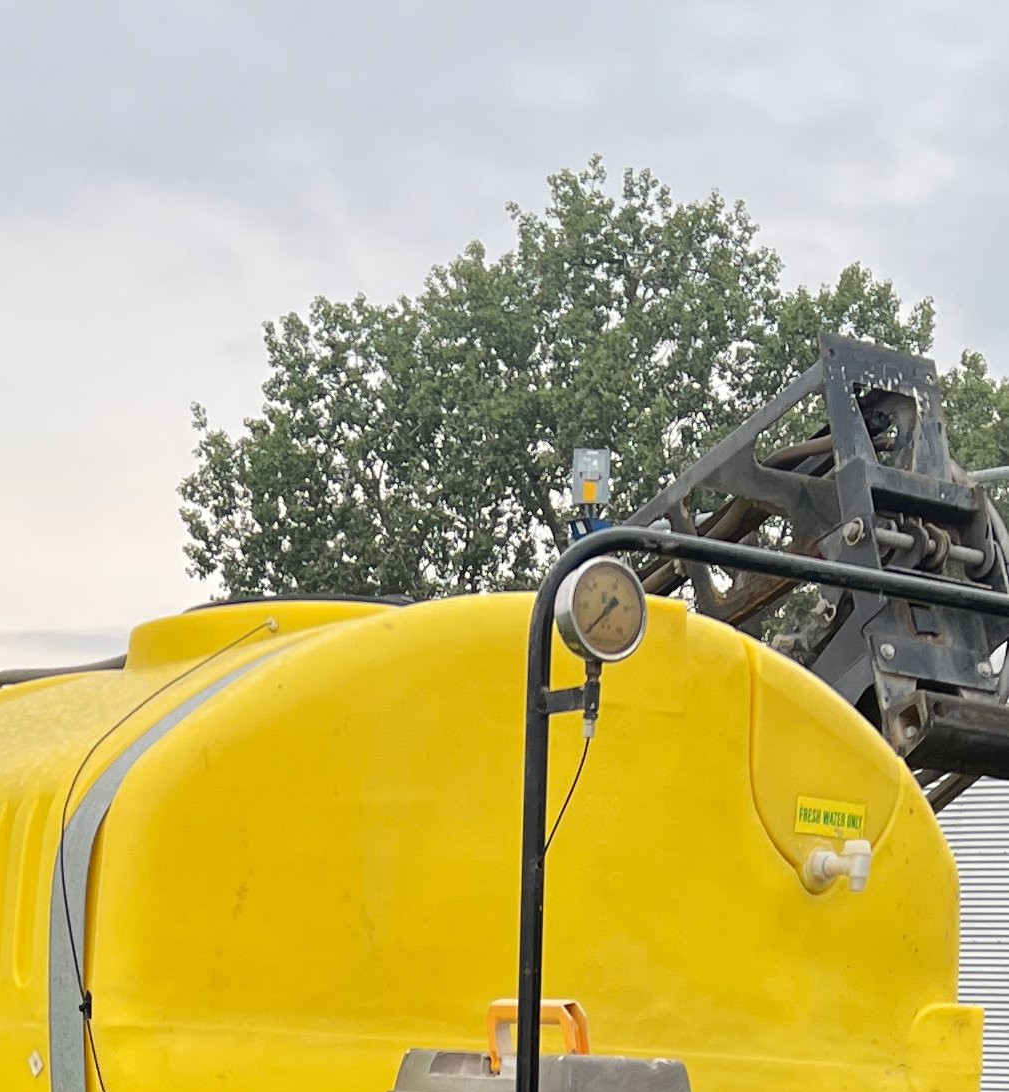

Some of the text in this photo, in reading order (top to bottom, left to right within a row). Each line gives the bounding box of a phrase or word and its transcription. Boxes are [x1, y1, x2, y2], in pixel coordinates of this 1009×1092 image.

[799, 808, 863, 829] FRESH WATER ONLY
